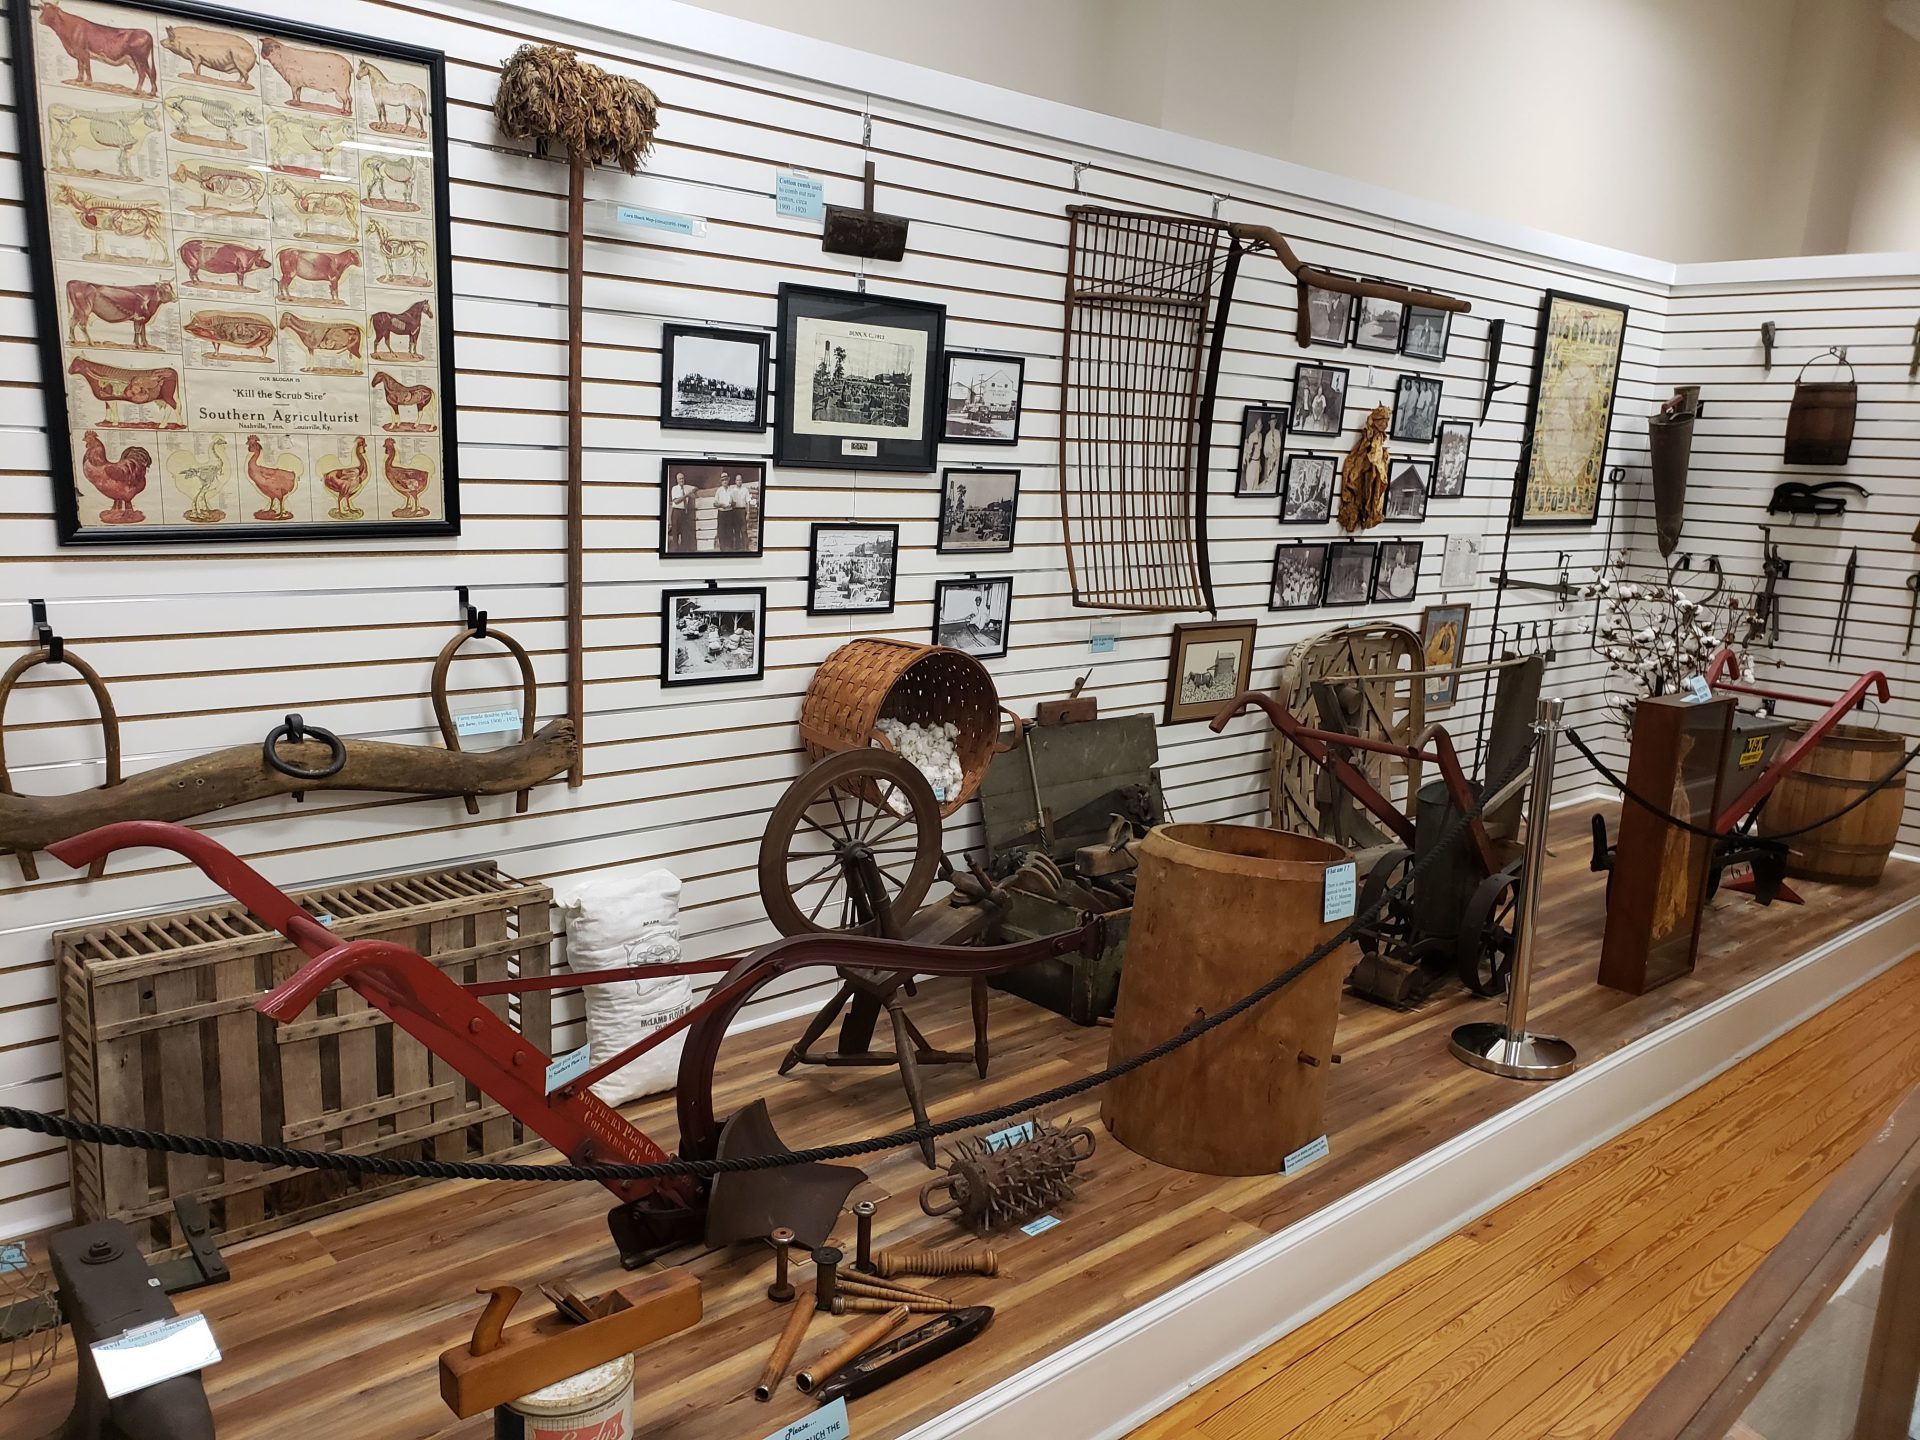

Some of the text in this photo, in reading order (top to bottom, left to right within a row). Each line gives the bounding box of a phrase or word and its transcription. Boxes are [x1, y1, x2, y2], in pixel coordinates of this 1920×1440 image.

[780, 178, 796, 186] Cotton
[258, 390, 272, 399] the
[275, 390, 302, 399] Scrub
[199, 408, 359, 423] Southern Agriculturist
[641, 1015, 667, 1027] McLAMB
[578, 1089, 620, 1131] SOUTHERN
[622, 1124, 644, 1149] PLOW
[128, 1332, 147, 1343] used
[804, 1421, 840, 1440] UCH THE
